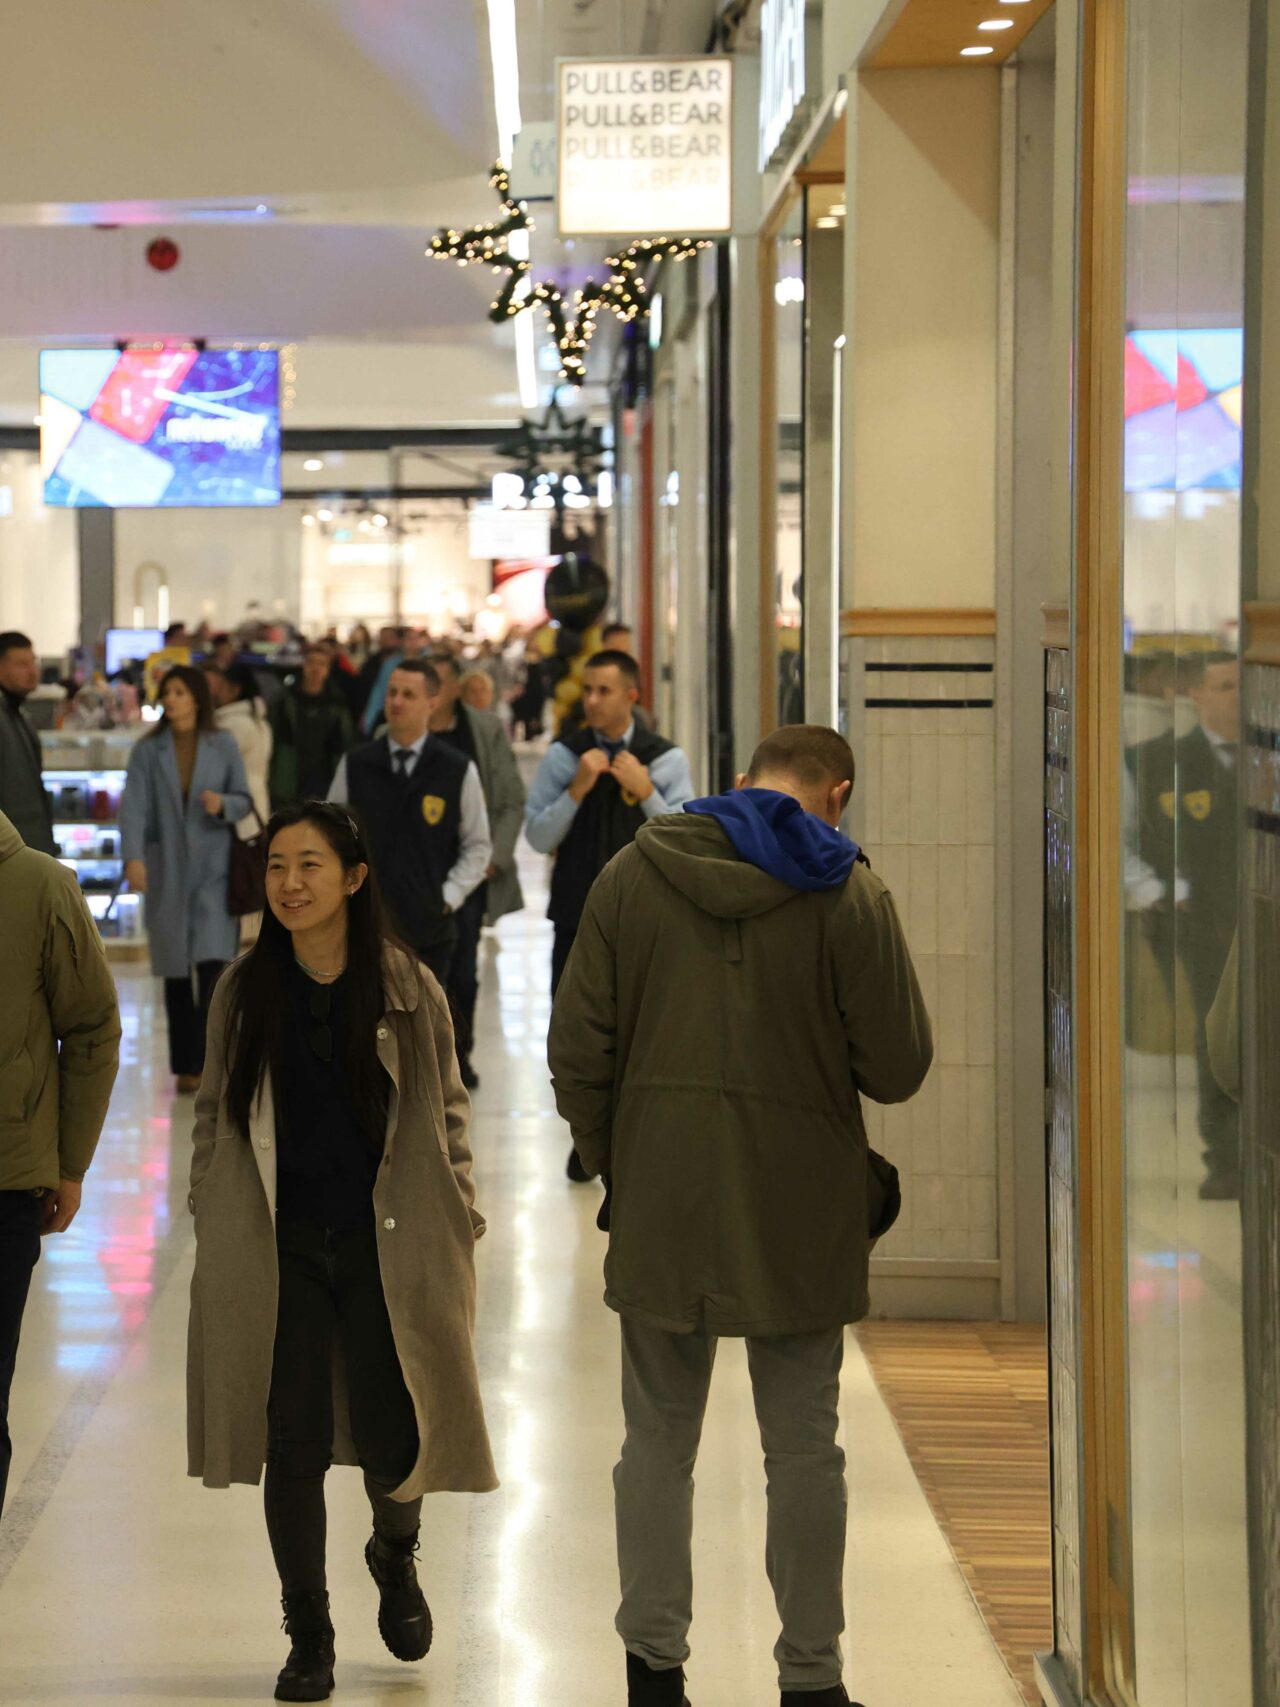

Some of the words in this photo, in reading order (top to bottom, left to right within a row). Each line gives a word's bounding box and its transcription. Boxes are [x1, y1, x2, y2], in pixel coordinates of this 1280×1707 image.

[566, 68, 722, 95] PULL&BEAR
[566, 101, 722, 128] PULL&BEAR
[566, 134, 722, 160] PULL&BEAR
